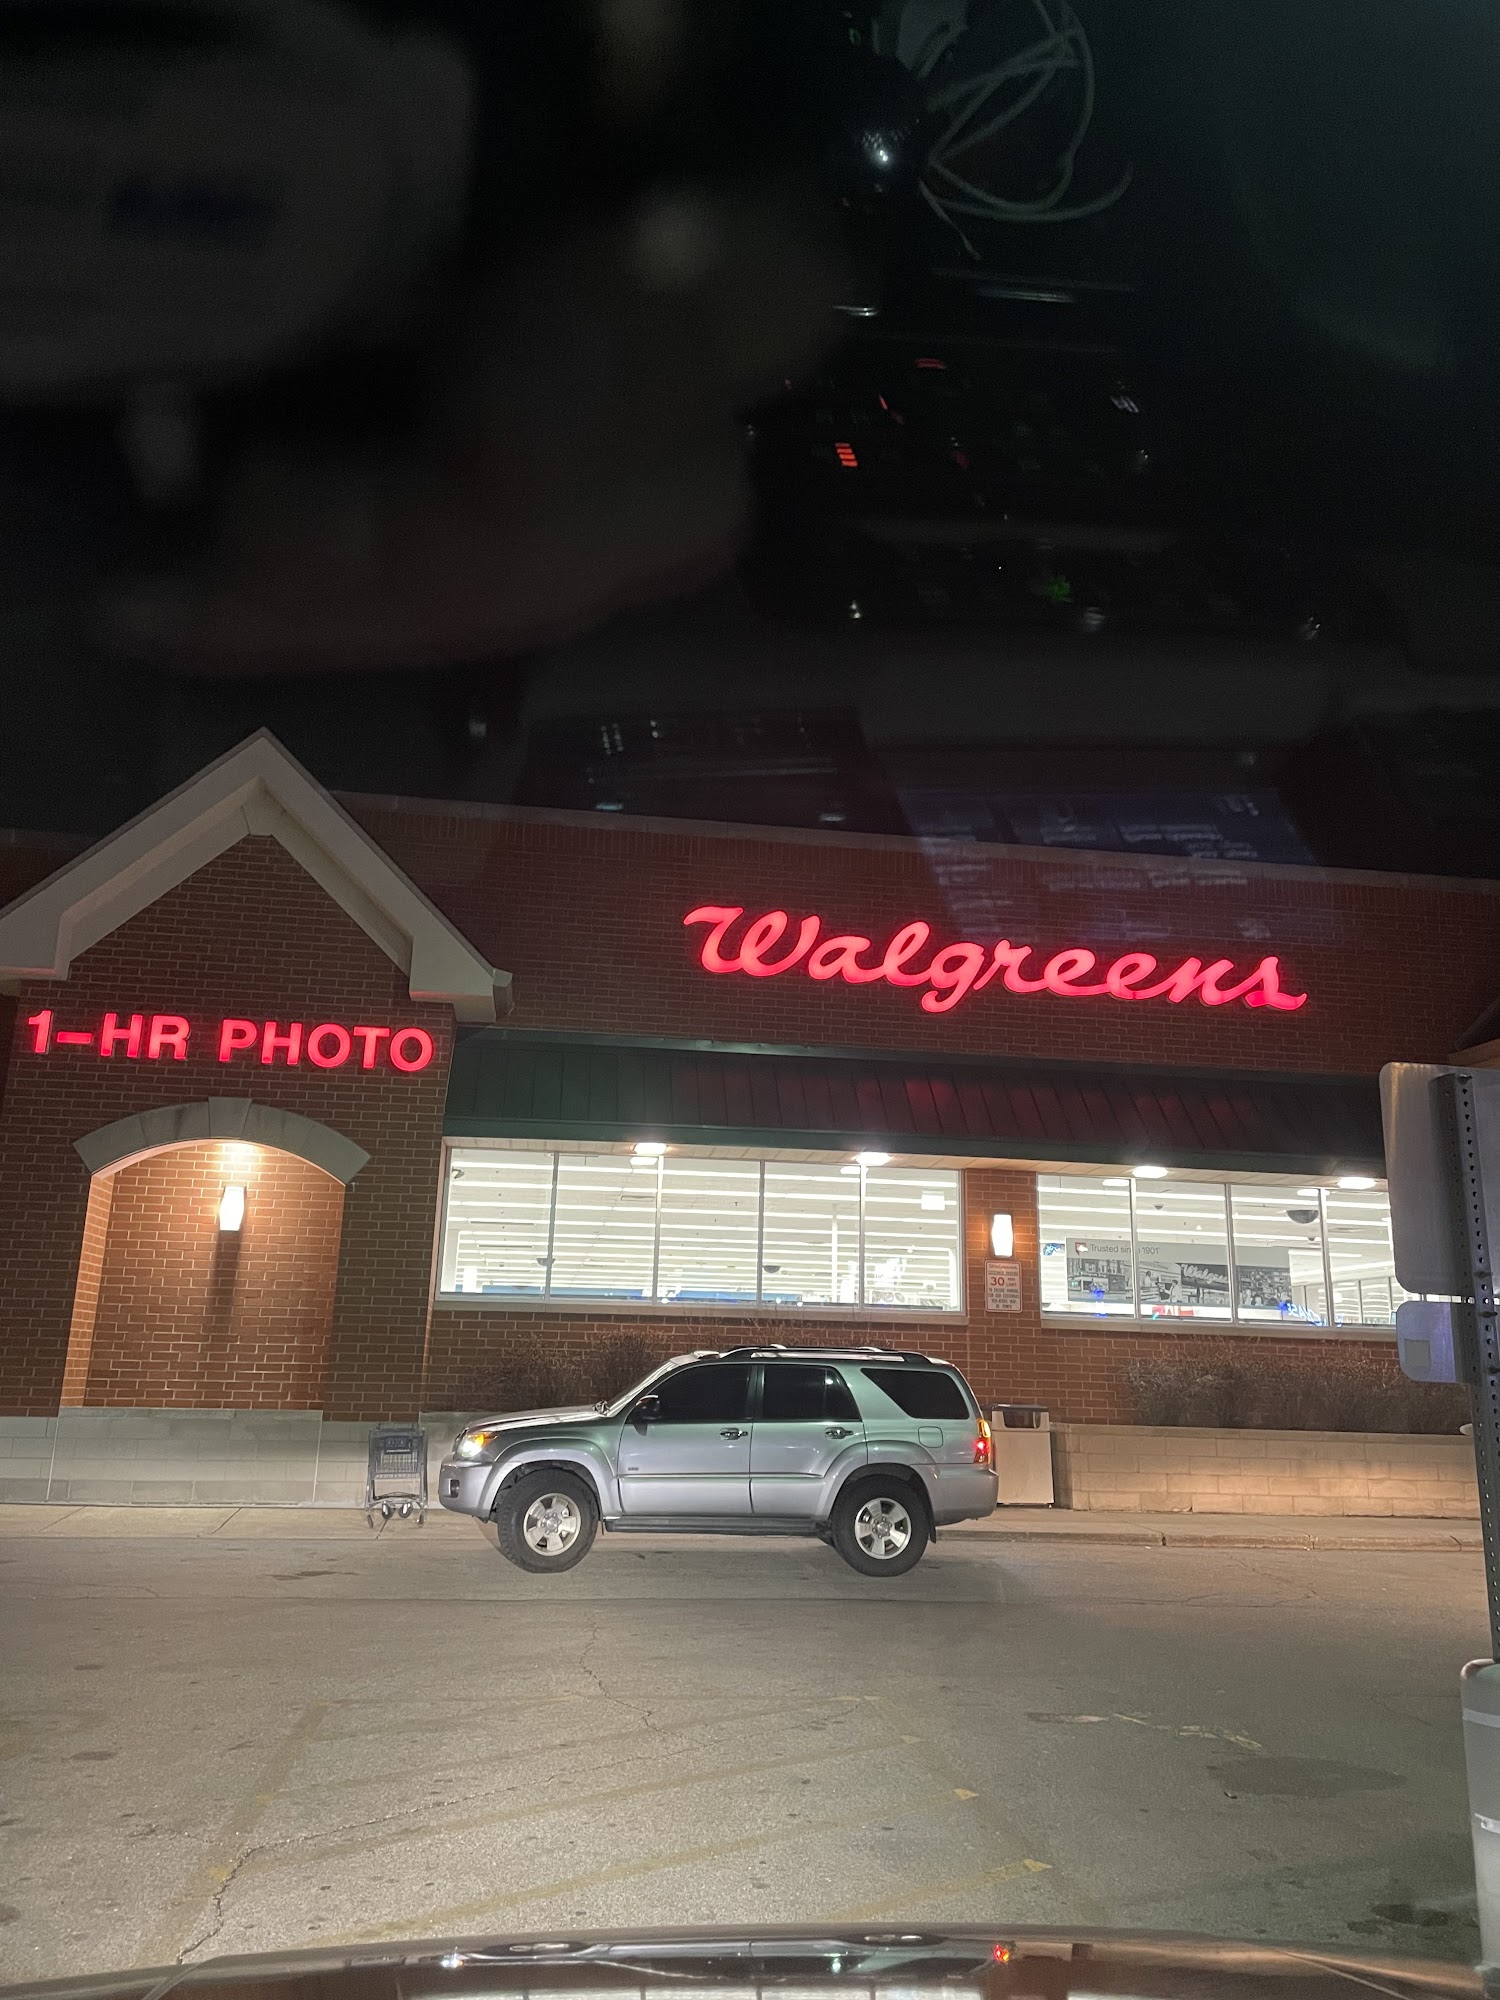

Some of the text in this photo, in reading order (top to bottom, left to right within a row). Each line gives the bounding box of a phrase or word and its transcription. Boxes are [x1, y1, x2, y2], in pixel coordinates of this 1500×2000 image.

[683, 905, 1307, 1012] Walgreens
[28, 1010, 434, 1072] 1-HR PHOTO
[1090, 1243, 1118, 1253] Trusted
[1142, 1246, 1158, 1255] 1901
[990, 1276, 1004, 1286] 30
